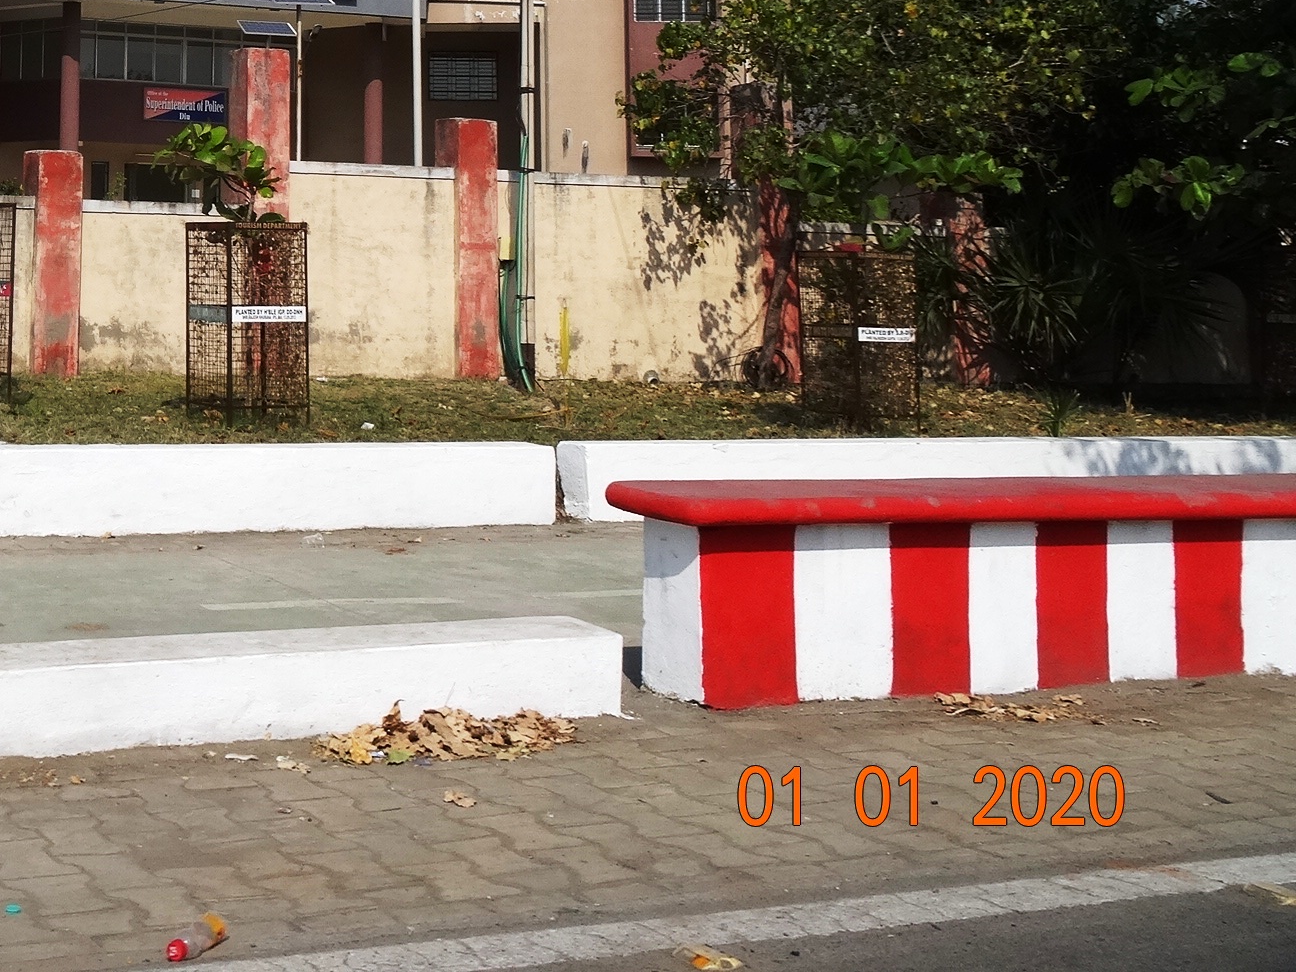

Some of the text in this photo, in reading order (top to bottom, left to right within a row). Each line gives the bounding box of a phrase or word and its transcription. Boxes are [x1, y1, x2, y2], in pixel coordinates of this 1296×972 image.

[146, 97, 224, 113] Superintendent of Police
